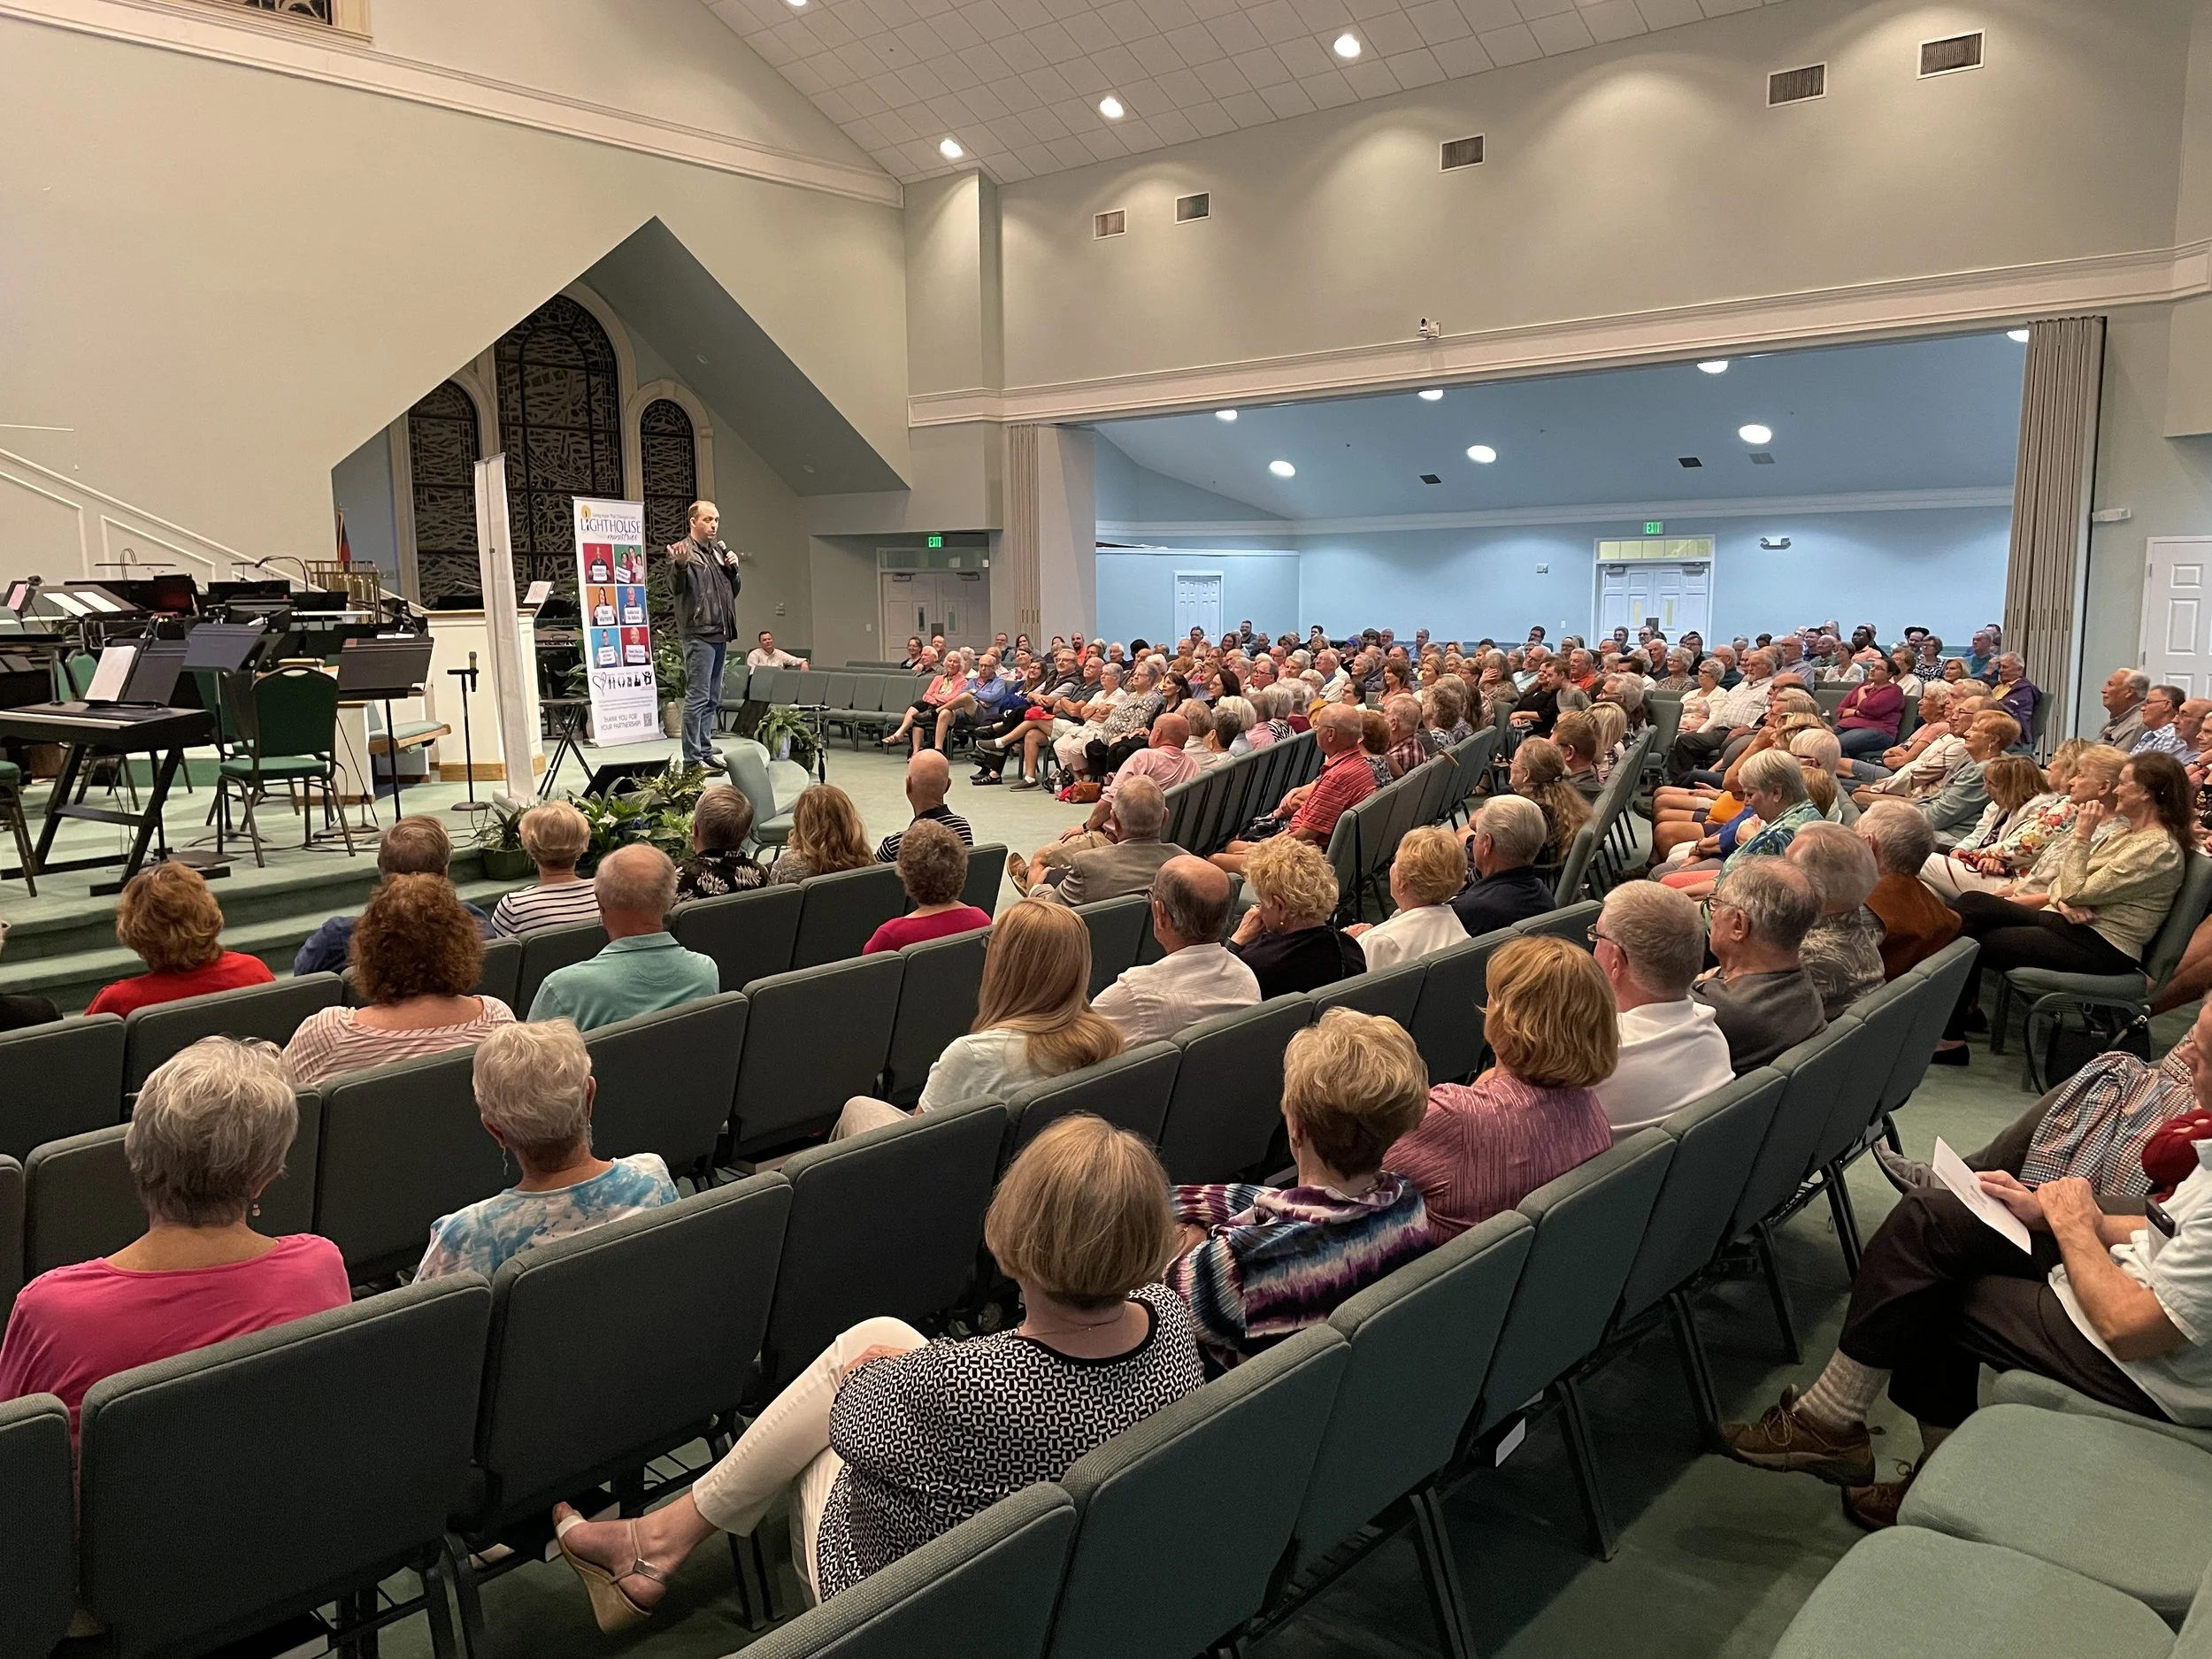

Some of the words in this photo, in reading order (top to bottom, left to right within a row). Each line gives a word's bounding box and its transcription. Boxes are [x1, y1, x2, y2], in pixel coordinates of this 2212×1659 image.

[580, 518, 641, 534] LIGHTHOUSE
[1647, 522, 1660, 534] EXIT
[928, 536, 941, 548] EXIT
